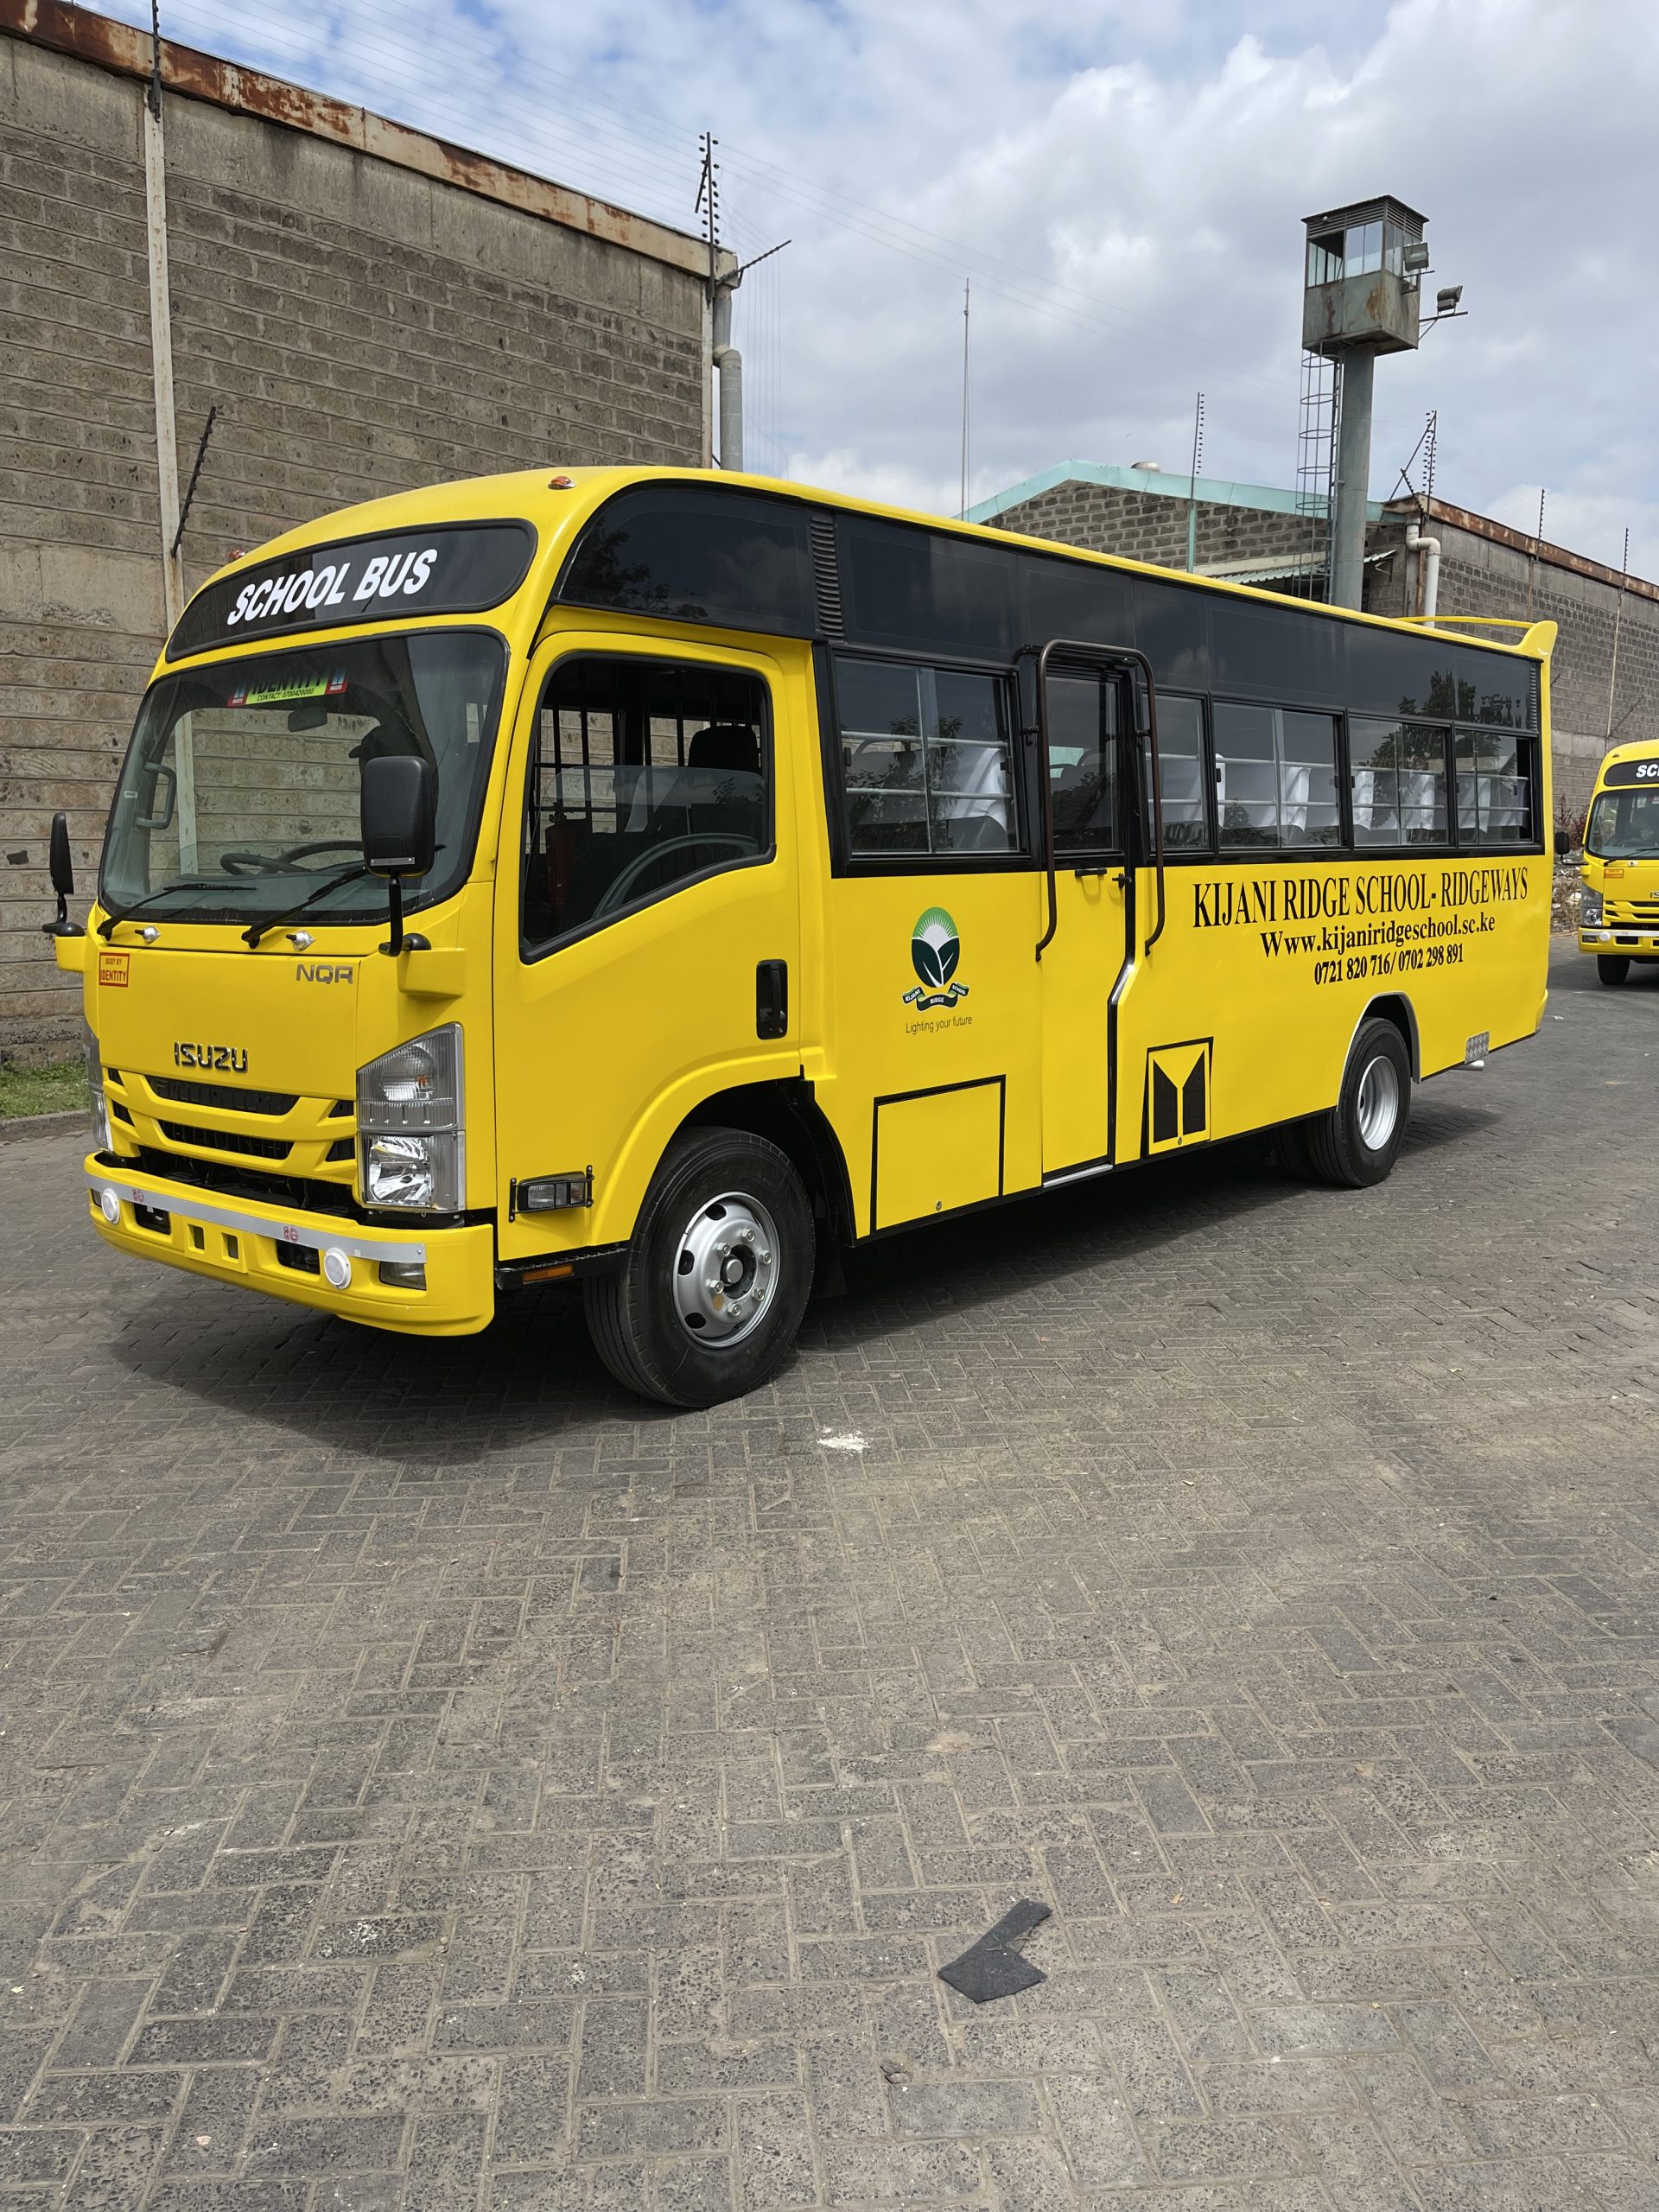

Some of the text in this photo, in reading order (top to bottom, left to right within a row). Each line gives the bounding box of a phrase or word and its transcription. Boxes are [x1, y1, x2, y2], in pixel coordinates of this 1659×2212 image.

[227, 549, 438, 626] SCHOOL BUS
[1636, 763, 1659, 778] SC
[1192, 880, 1277, 928] KIJANI
[1282, 876, 1351, 921] RIDGE
[1440, 866, 1529, 907] RIDGEWAYS
[1260, 912, 1496, 958] Www.kijaniridgeschool.sc.ke
[100, 969, 127, 982] IDENTITY
[296, 963, 354, 984] NQR
[1314, 959, 1344, 986] 0721
[1346, 956, 1368, 981] 820
[1397, 948, 1424, 972] 0702
[1426, 944, 1445, 968] 298
[1446, 943, 1464, 965] 891
[905, 983, 966, 1005] KIJANI RIDGE SCHOOL
[906, 1015, 973, 1035] Lighting your future
[174, 1041, 249, 1073] ISUZU
